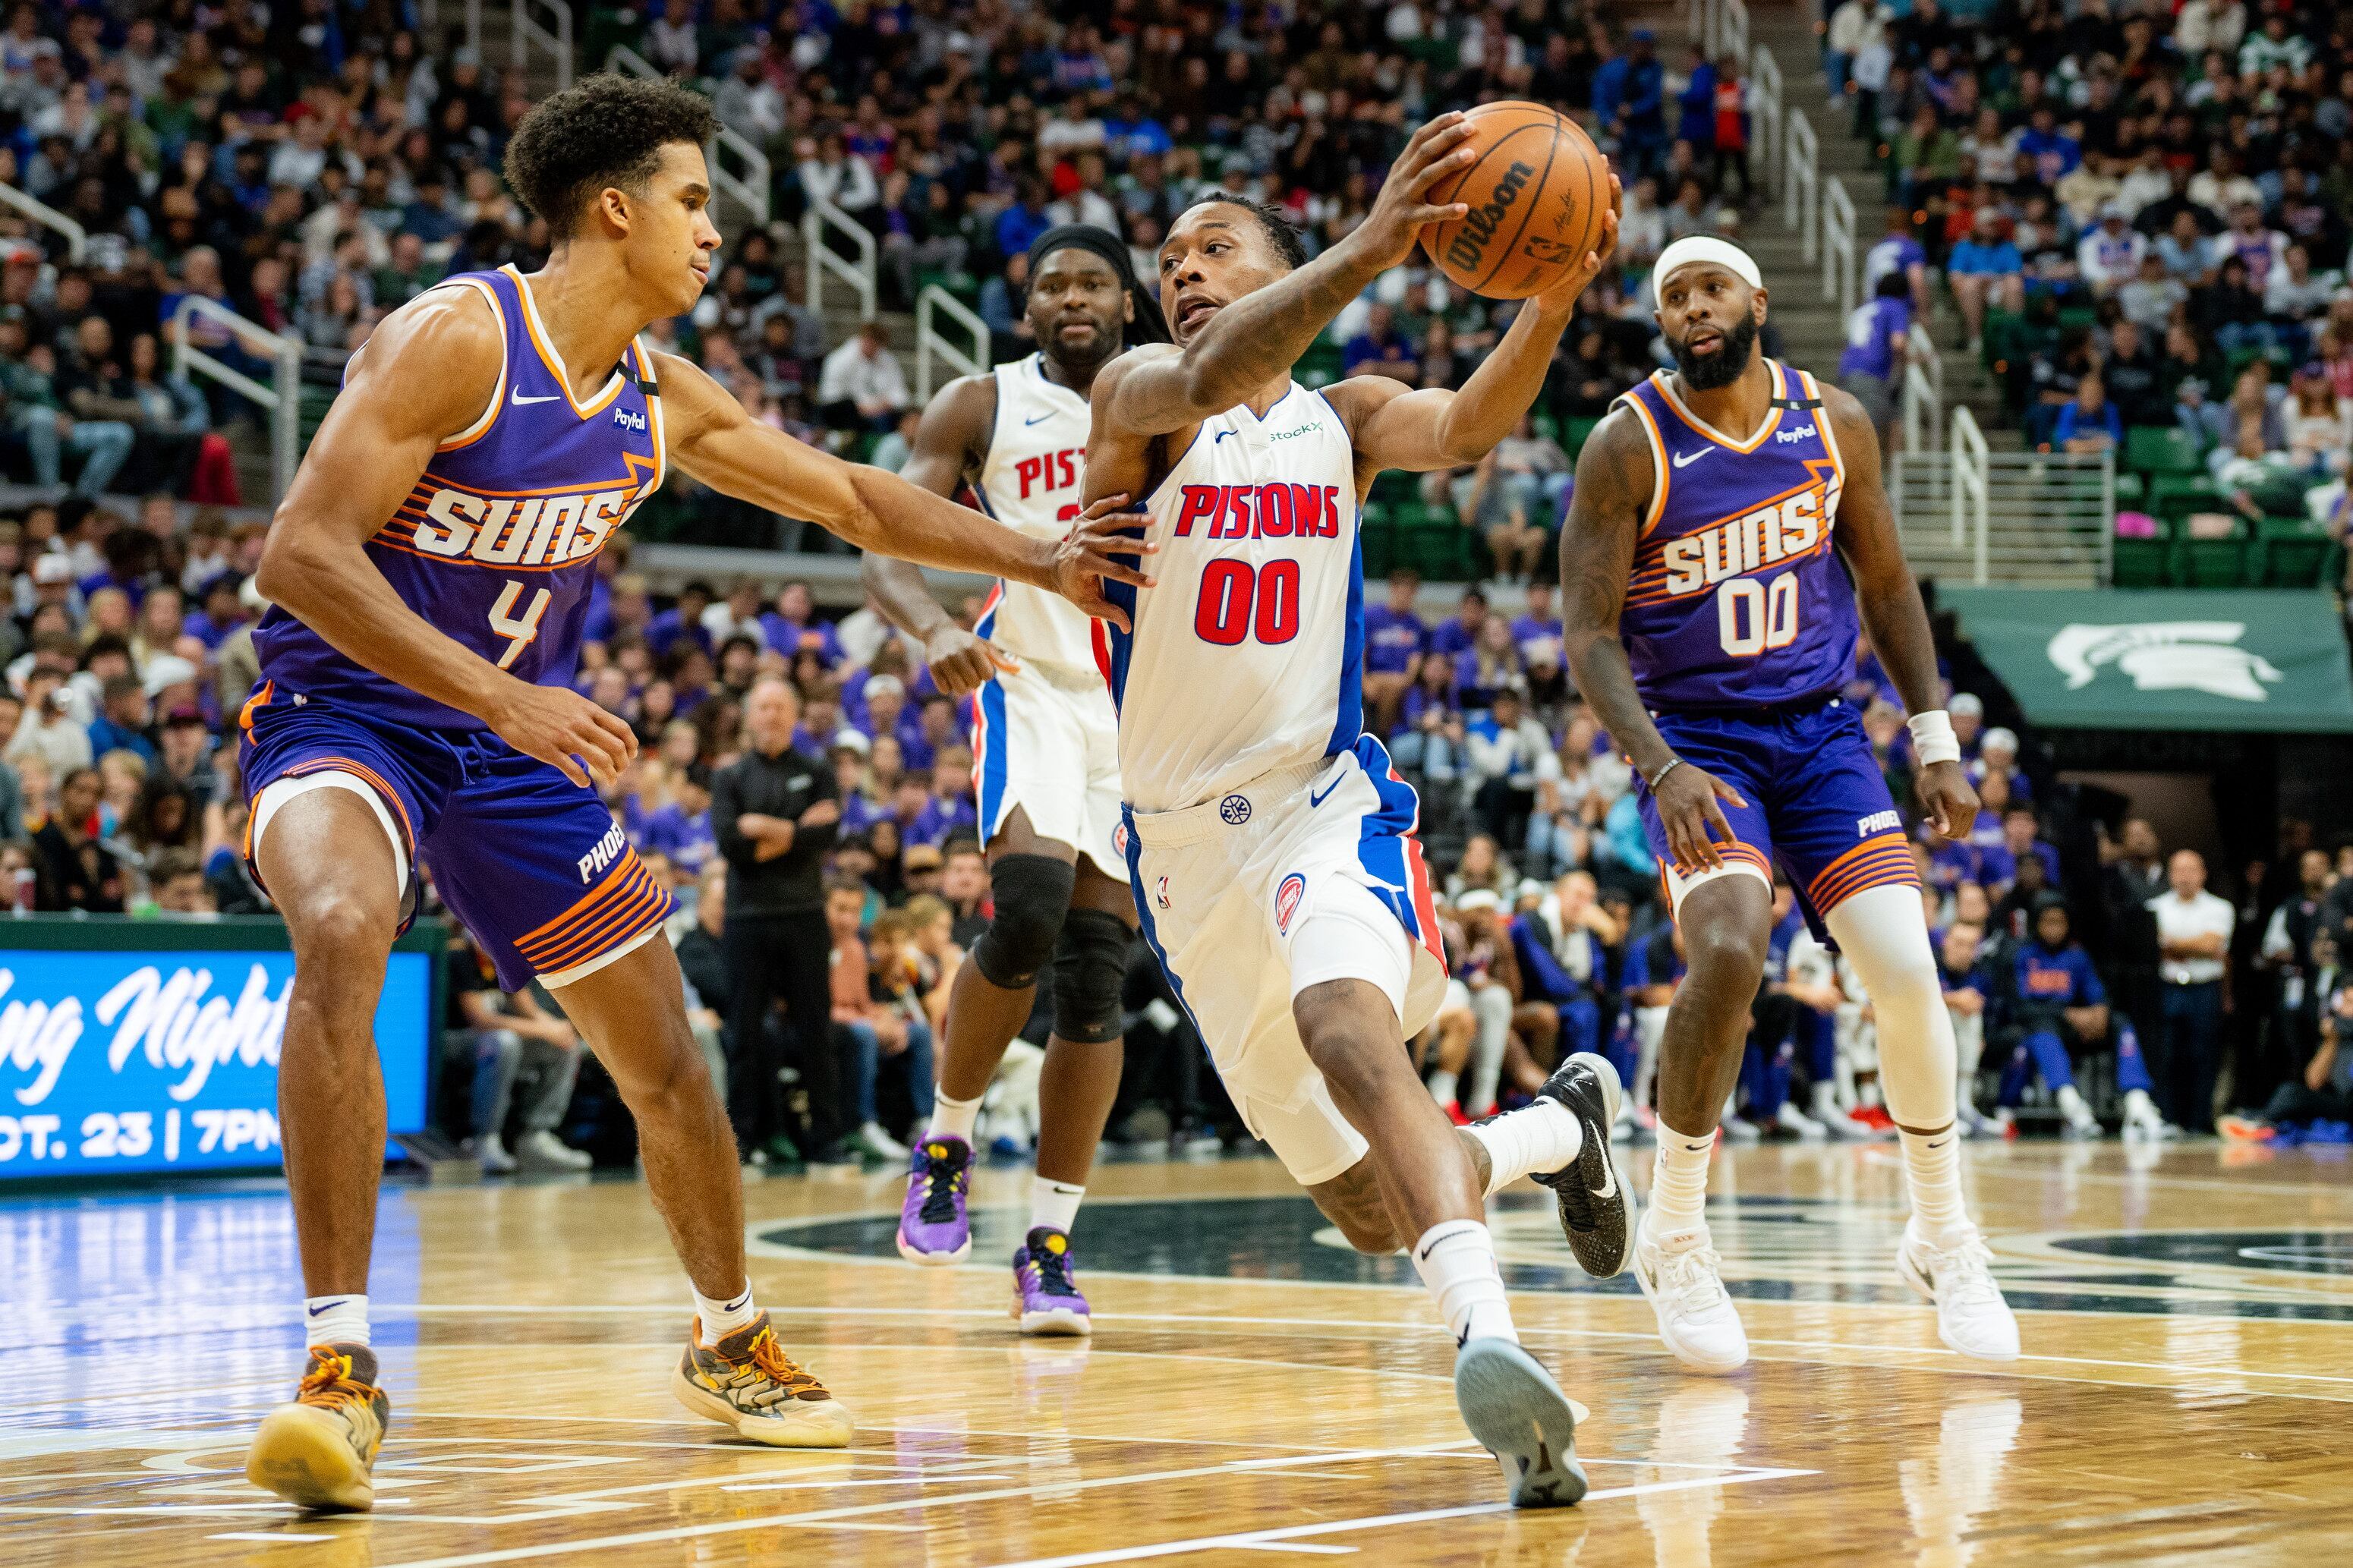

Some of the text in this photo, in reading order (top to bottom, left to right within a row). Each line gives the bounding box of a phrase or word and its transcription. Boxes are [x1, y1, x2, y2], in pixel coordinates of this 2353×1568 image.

[1447, 160, 1536, 272] Wilson
[614, 408, 645, 430] PayPal
[1776, 423, 1817, 443] PayPal
[1173, 482, 1340, 540] PISTONS
[487, 579, 553, 670] 4
[1194, 558, 1301, 647] 00
[1717, 571, 1799, 659] 00
[80, 1112, 153, 1158] 23
